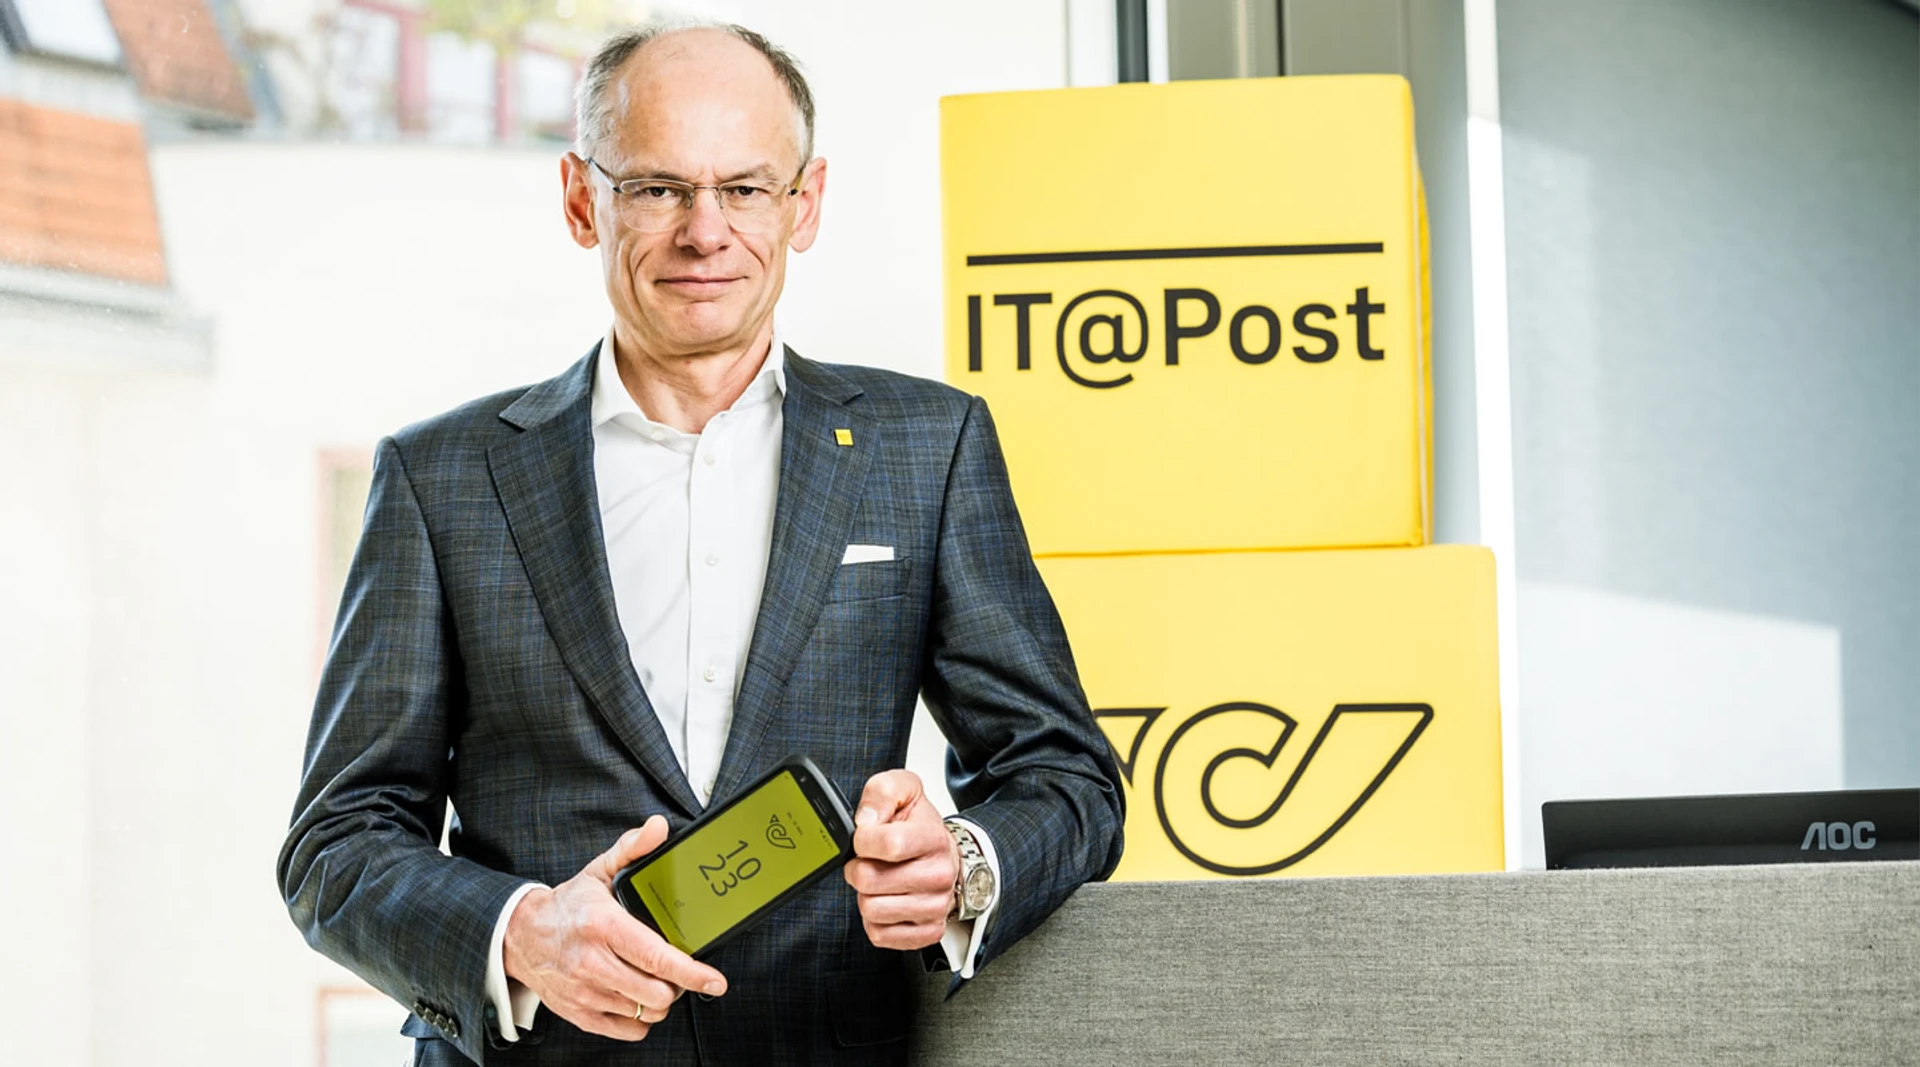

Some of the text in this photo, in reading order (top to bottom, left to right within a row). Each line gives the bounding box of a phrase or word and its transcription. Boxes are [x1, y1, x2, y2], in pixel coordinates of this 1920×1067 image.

[967, 287, 1386, 389] IT@Post
[1800, 821, 1876, 851] AOC
[697, 854, 739, 897] 23
[724, 840, 762, 881] 10
